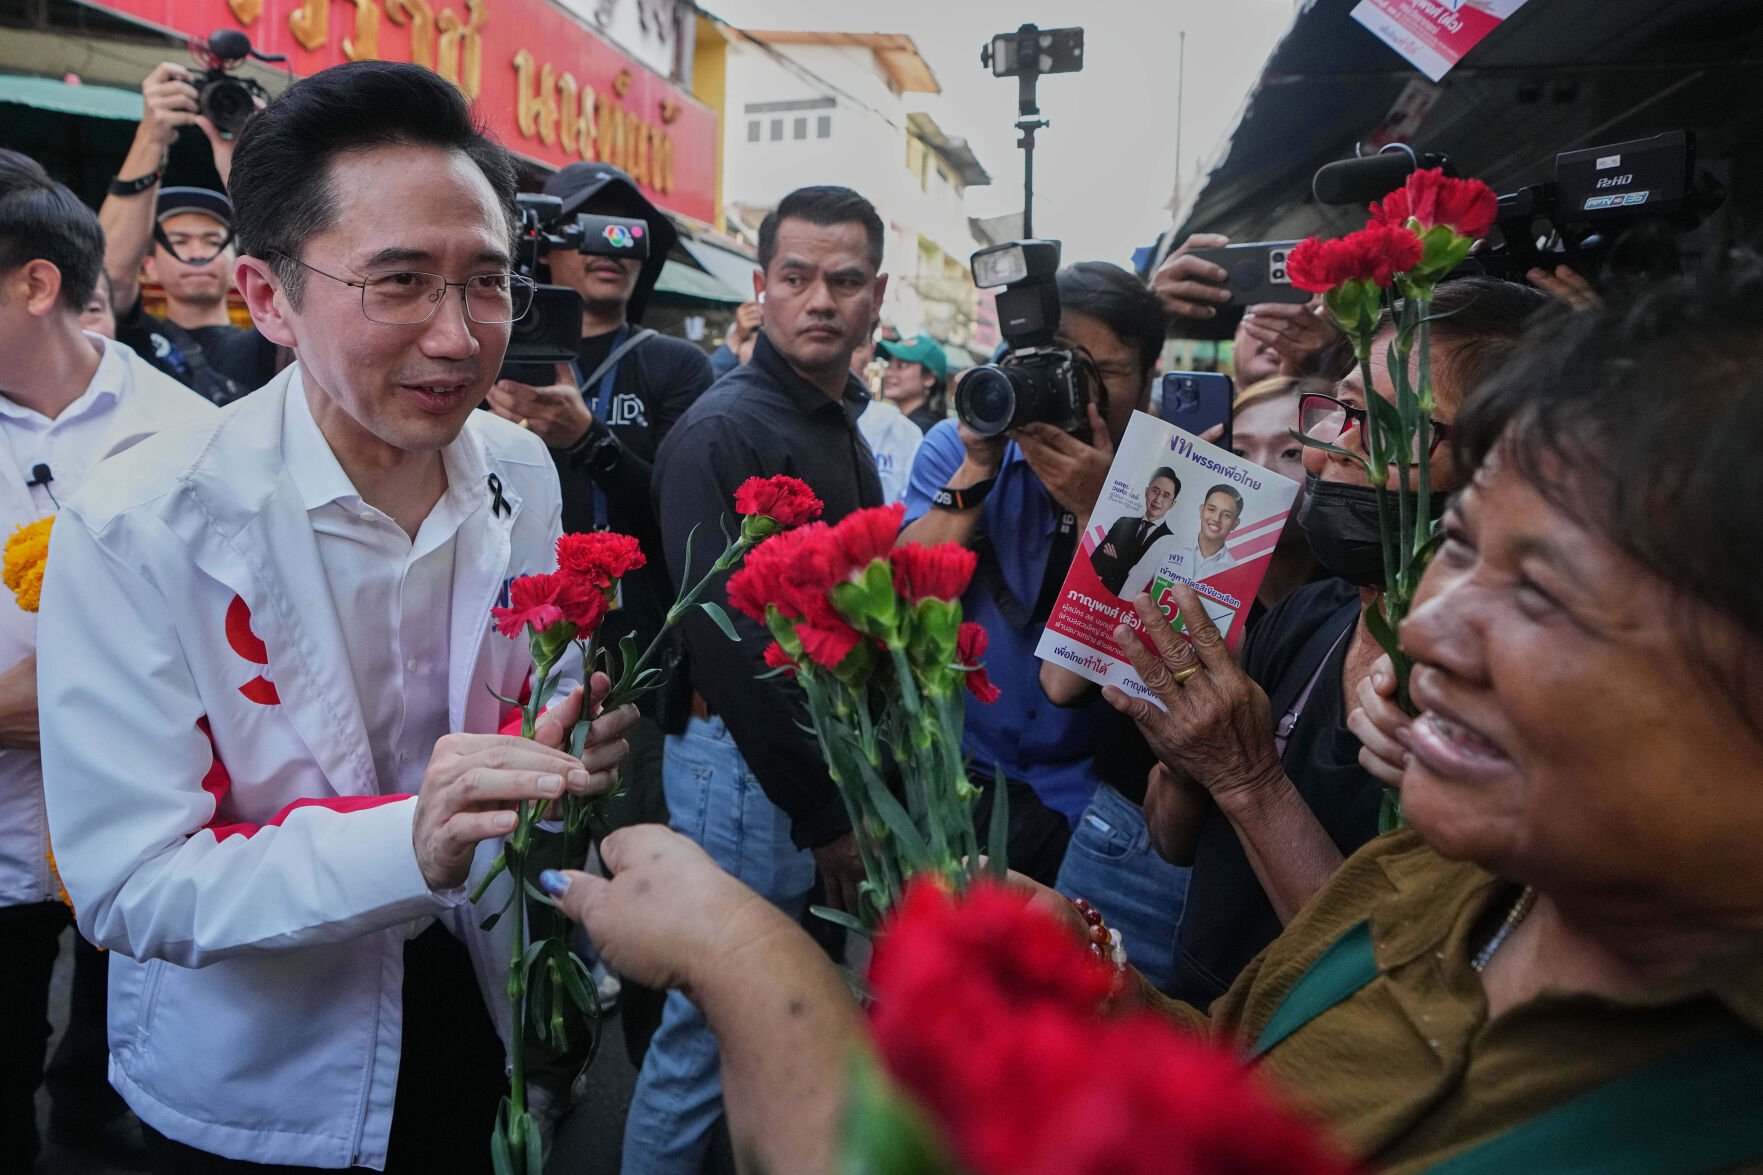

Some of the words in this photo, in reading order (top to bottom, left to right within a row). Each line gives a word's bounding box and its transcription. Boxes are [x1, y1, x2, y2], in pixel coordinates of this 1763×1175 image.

[1595, 174, 1633, 188] P2HD
[1192, 452, 1262, 491] พรรคเพื่อไทย
[1157, 587, 1180, 623] 5
